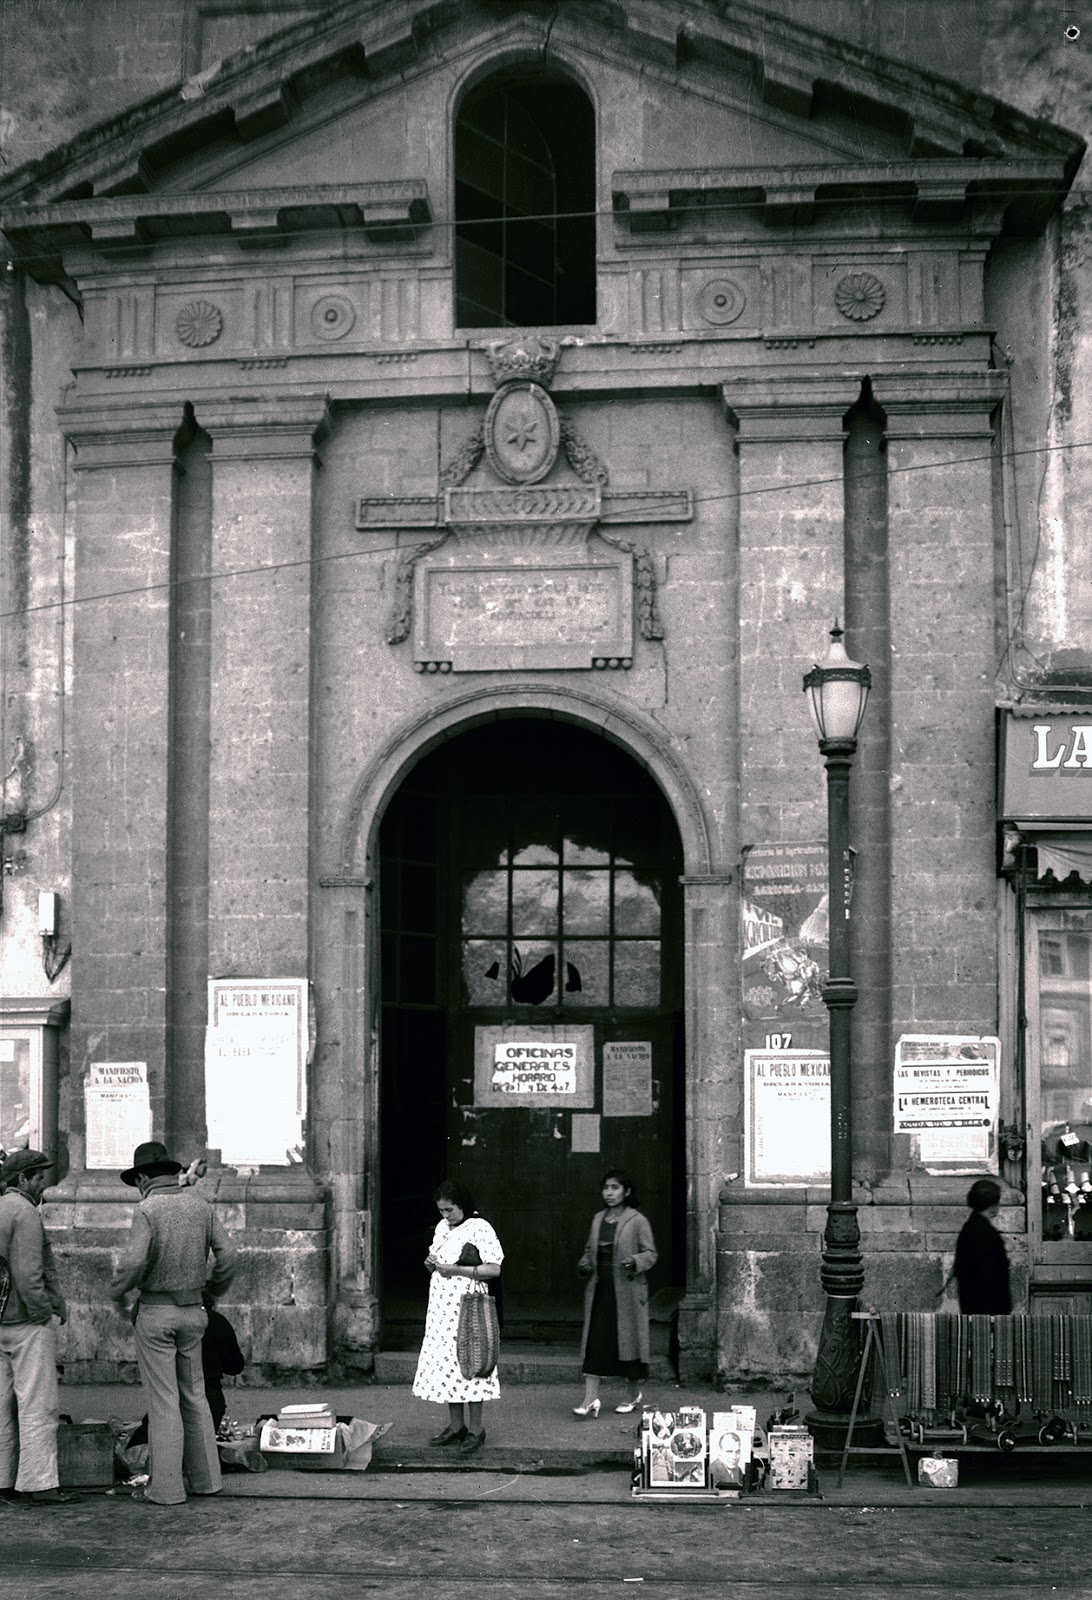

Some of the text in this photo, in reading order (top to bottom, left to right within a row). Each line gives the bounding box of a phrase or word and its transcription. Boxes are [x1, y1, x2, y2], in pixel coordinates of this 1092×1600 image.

[1033, 725, 1092, 769] LA
[220, 993, 296, 1007] AL PUEBLO MEXICANO
[766, 1033, 792, 1050] 107
[506, 1047, 574, 1059] OFICINAS
[494, 1061, 570, 1073] GENERALES
[757, 1063, 831, 1077] AL PUEBLO MEXICAN
[898, 1070, 909, 1078] LAS
[914, 1069, 941, 1077] REVISTAS
[956, 1068, 990, 1076] PERIODICOS
[513, 1073, 556, 1082] HORARIO
[899, 1095, 990, 1111] LA HEMEROTECA CENTRAL
